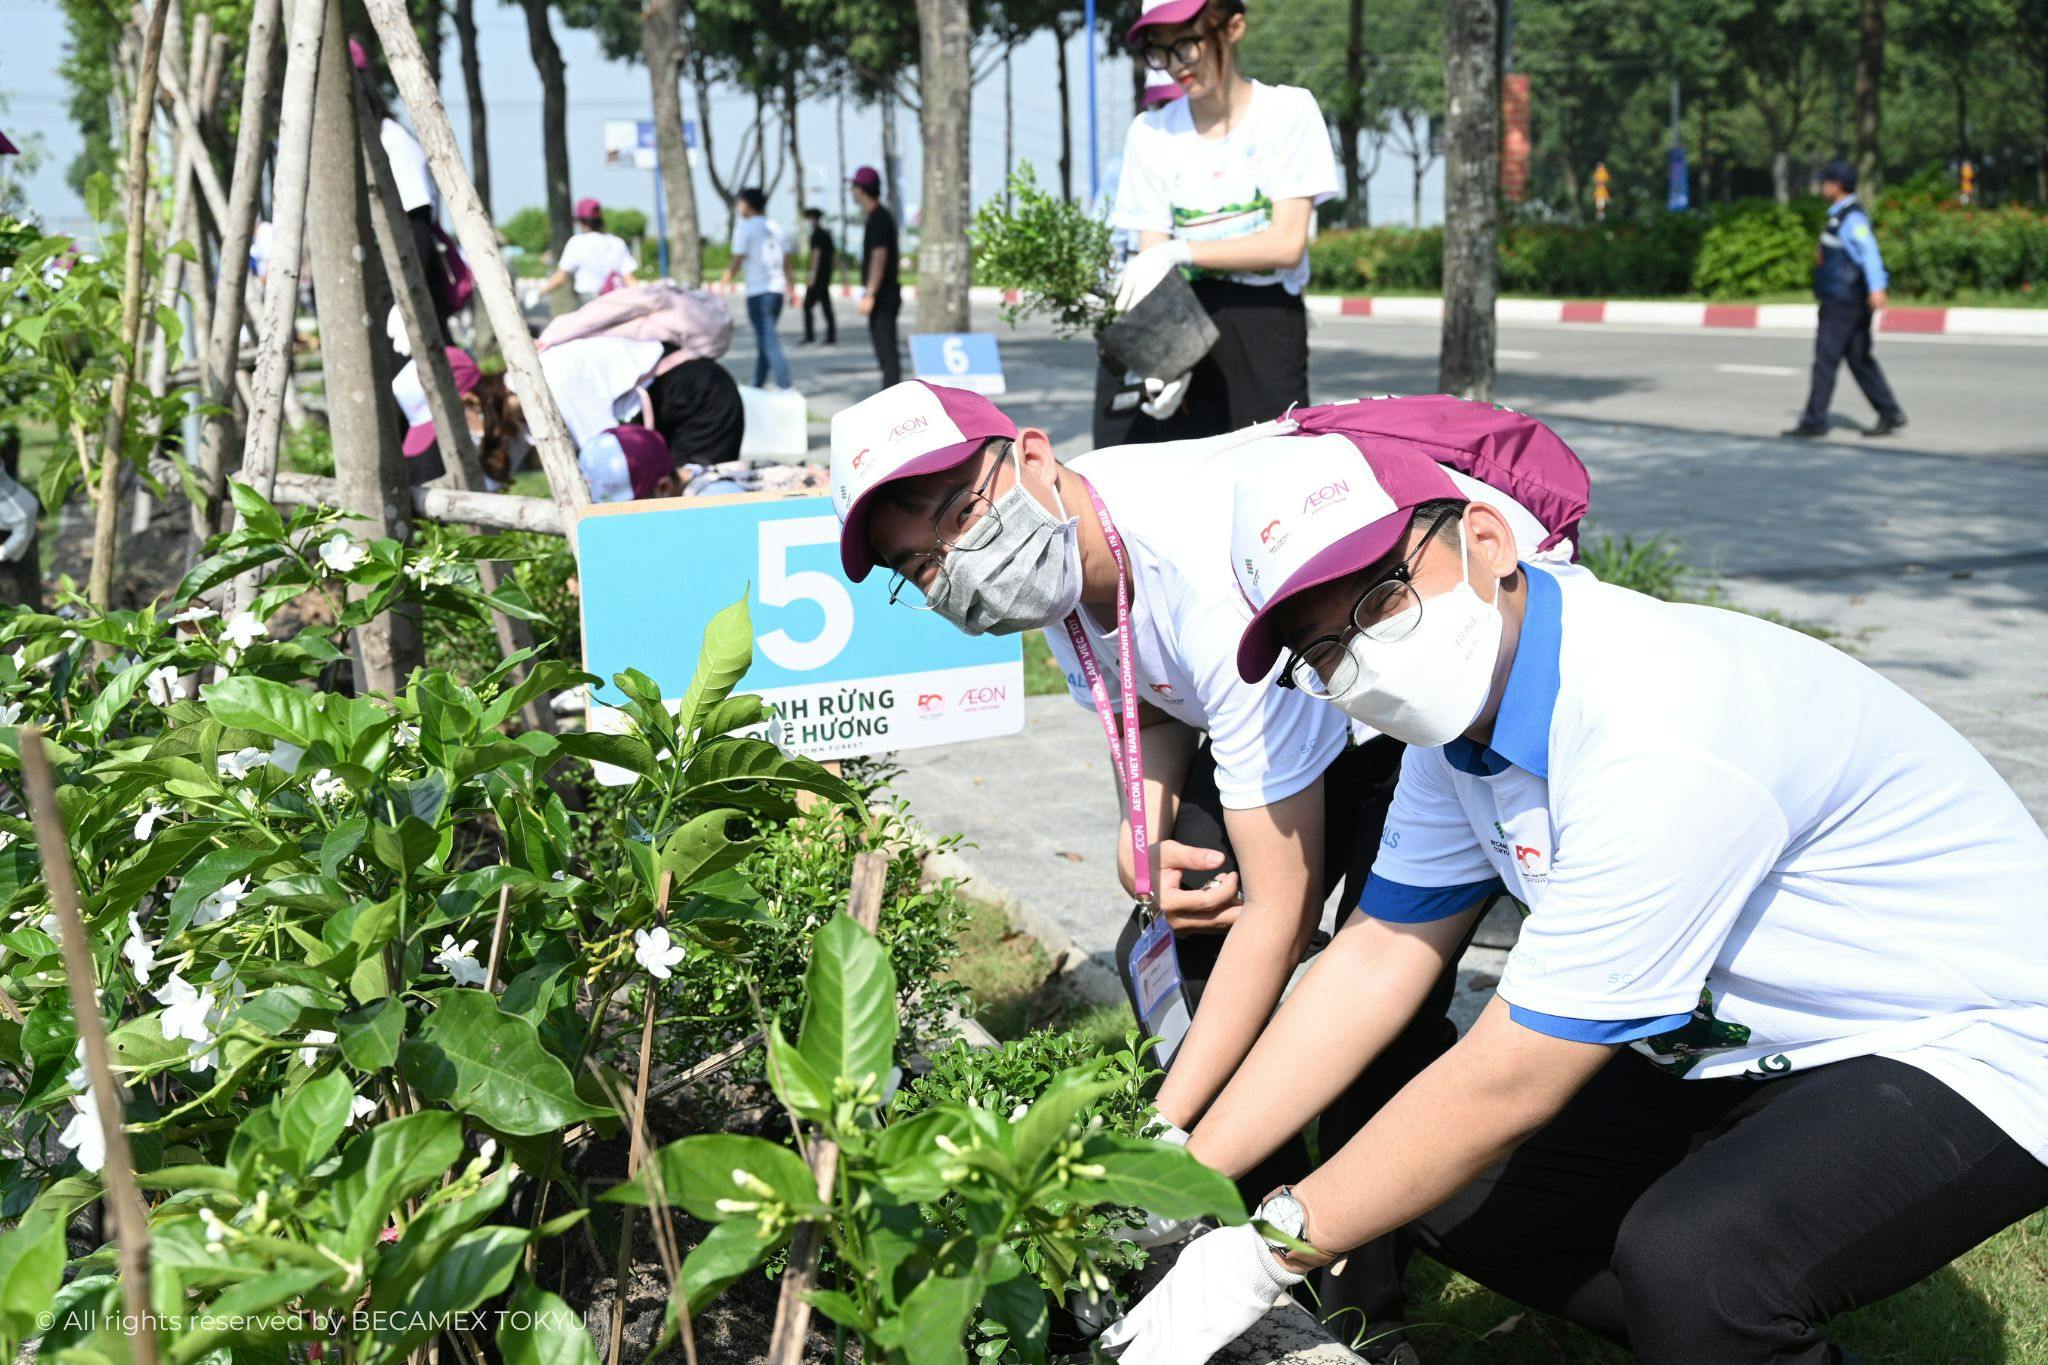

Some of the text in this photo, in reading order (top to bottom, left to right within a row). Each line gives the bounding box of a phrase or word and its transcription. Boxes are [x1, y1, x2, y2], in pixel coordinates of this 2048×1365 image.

[942, 336, 970, 375] 6
[1098, 508, 1114, 533] ASIA
[1108, 535, 1119, 548] IN
[756, 515, 854, 671] 5
[1120, 608, 1128, 622] TO
[1121, 625, 1132, 689] COMPANIES
[819, 688, 895, 716] RỪNG
[1126, 692, 1135, 719] BEST
[802, 716, 888, 744] HƯƠNG
[1102, 709, 1115, 735] NAM
[1127, 728, 1138, 754] NAM
[1131, 782, 1142, 812] AEON
